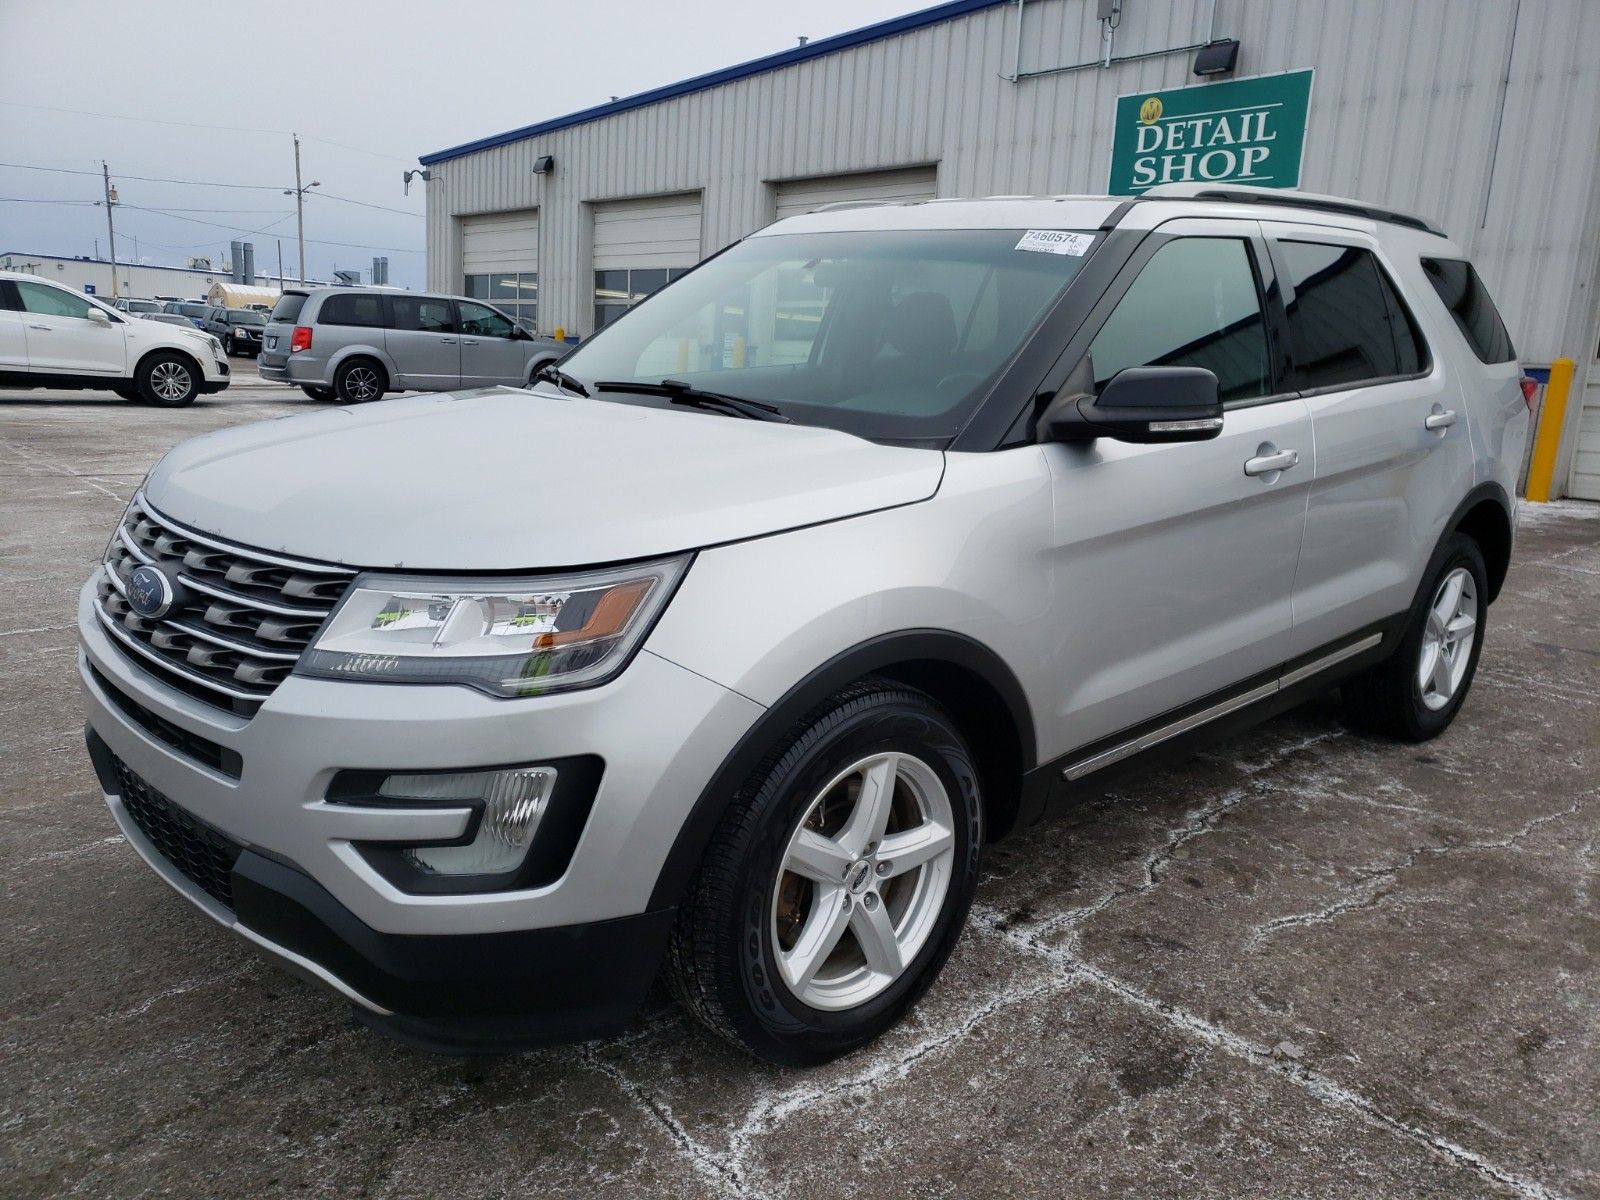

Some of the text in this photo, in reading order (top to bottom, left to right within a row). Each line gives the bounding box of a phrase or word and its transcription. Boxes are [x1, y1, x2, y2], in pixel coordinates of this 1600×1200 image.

[1136, 112, 1277, 154] DETAIL
[1132, 146, 1270, 186] SHOP
[1026, 231, 1079, 243] 7460574
